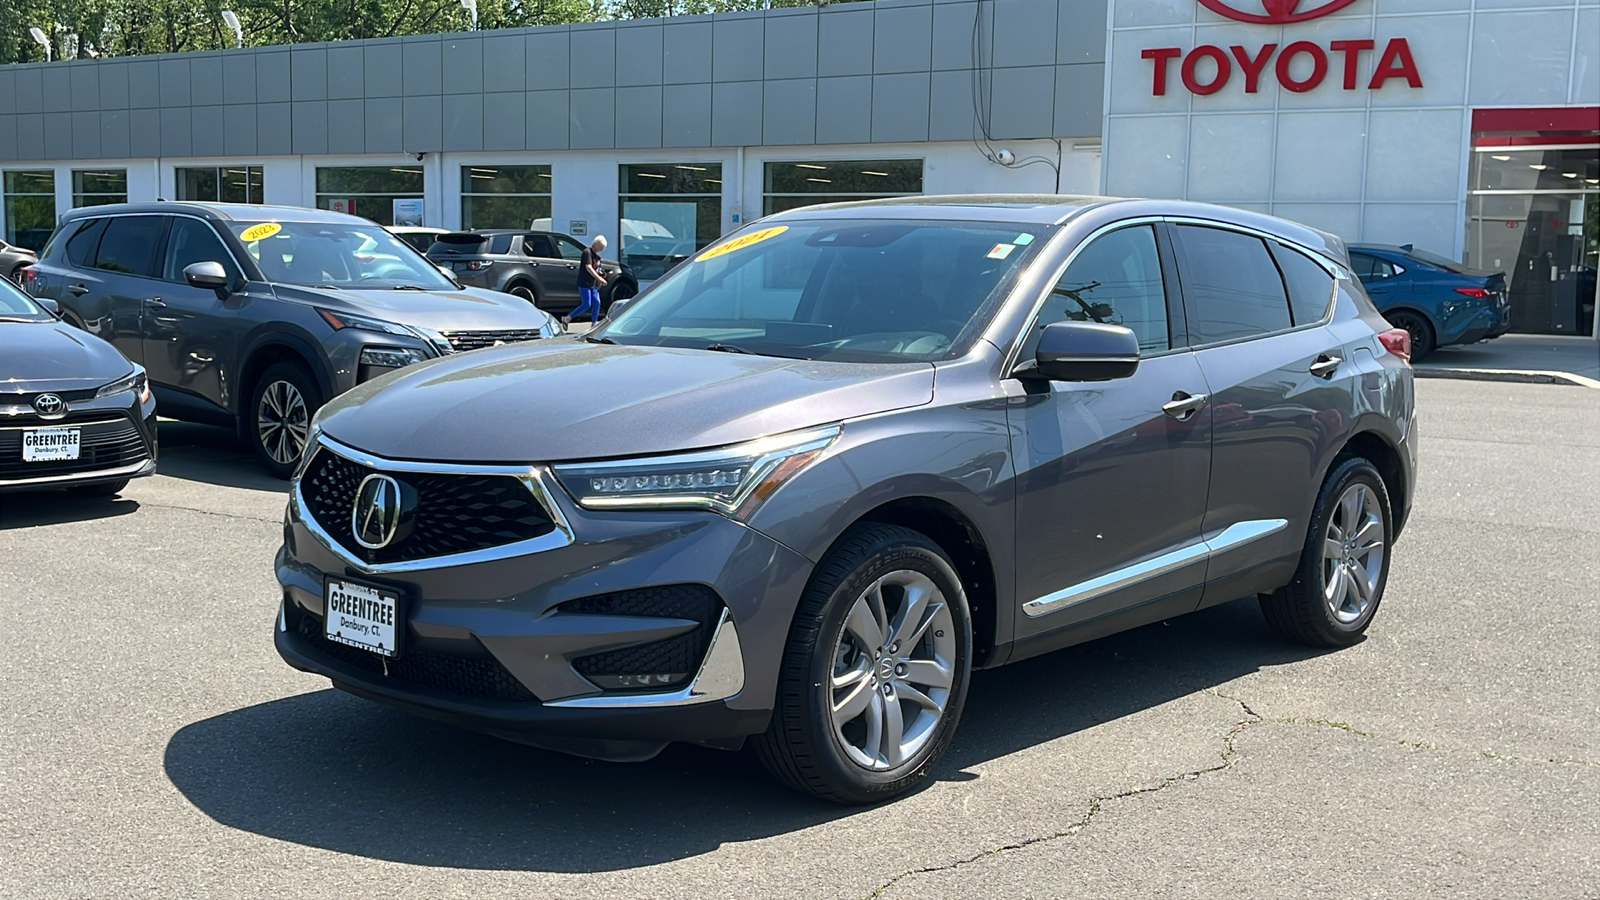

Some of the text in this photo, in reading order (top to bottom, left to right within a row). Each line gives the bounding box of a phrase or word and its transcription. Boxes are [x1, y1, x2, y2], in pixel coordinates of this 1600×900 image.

[1141, 38, 1423, 96] TOYOTA
[248, 224, 275, 239] 2023
[709, 230, 773, 257] 2021
[25, 433, 78, 446] GREENTREE
[331, 590, 393, 626] GREENTREE
[340, 616, 381, 637] Danbury, CT.
[327, 634, 392, 657] GREENTREE
